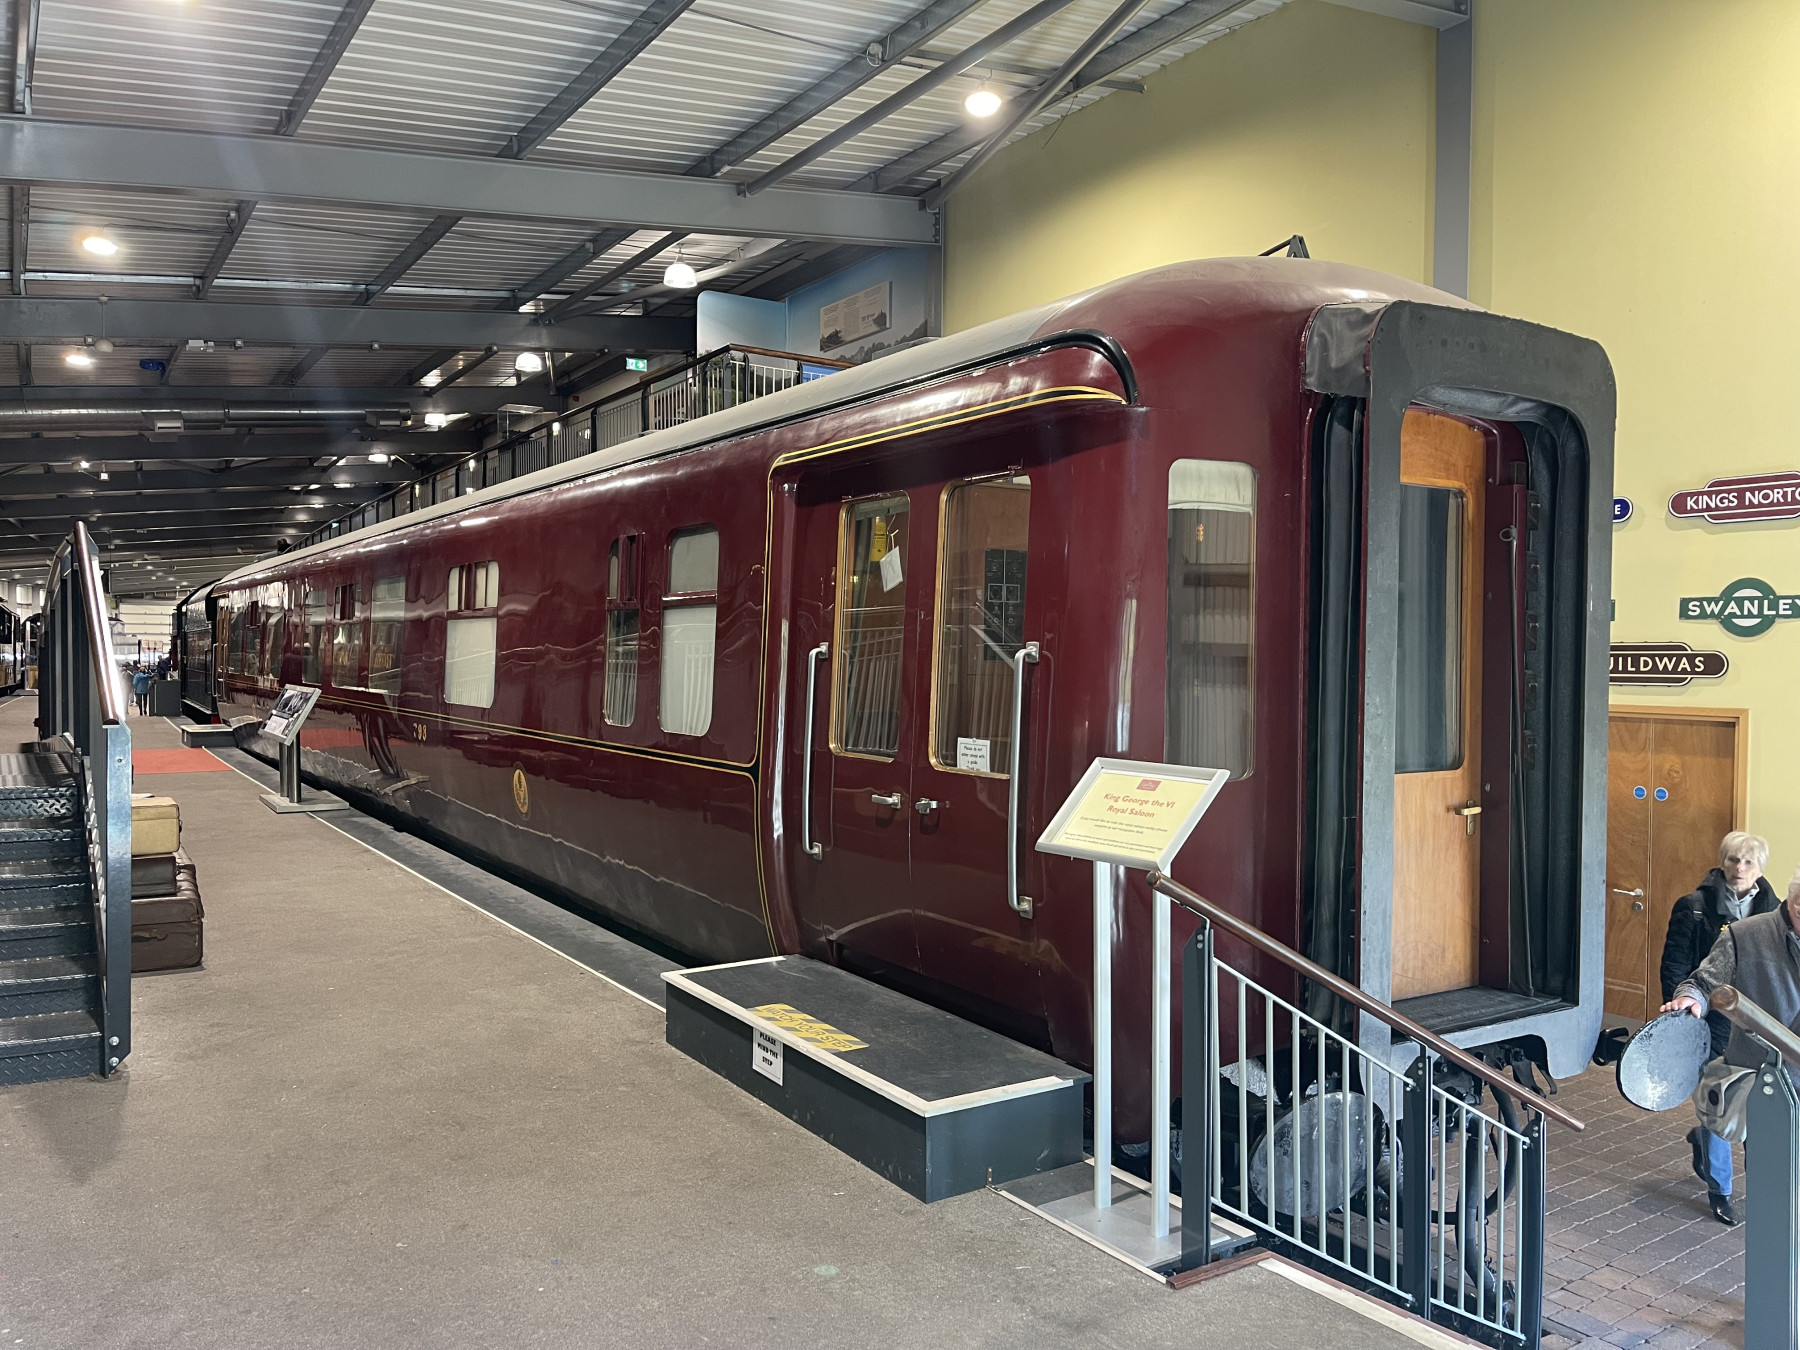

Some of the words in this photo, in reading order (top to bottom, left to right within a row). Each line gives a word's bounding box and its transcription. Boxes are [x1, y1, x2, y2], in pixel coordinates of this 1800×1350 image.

[1686, 492, 1738, 511] KINGS
[413, 723, 427, 741] 798
[1103, 793, 1120, 803] King
[1122, 795, 1150, 806] George
[1151, 799, 1165, 808] the
[1166, 801, 1176, 809] VI
[1107, 804, 1128, 814] Royal
[1128, 808, 1155, 818] Saloon
[762, 1007, 799, 1023] WATCH
[795, 1021, 826, 1037] YOUR
[820, 1036, 853, 1049] STEP
[759, 1031, 776, 1046] PLEASE
[757, 1042, 769, 1053] MIND
[769, 1049, 778, 1059] THE
[762, 1056, 773, 1066] STEP
